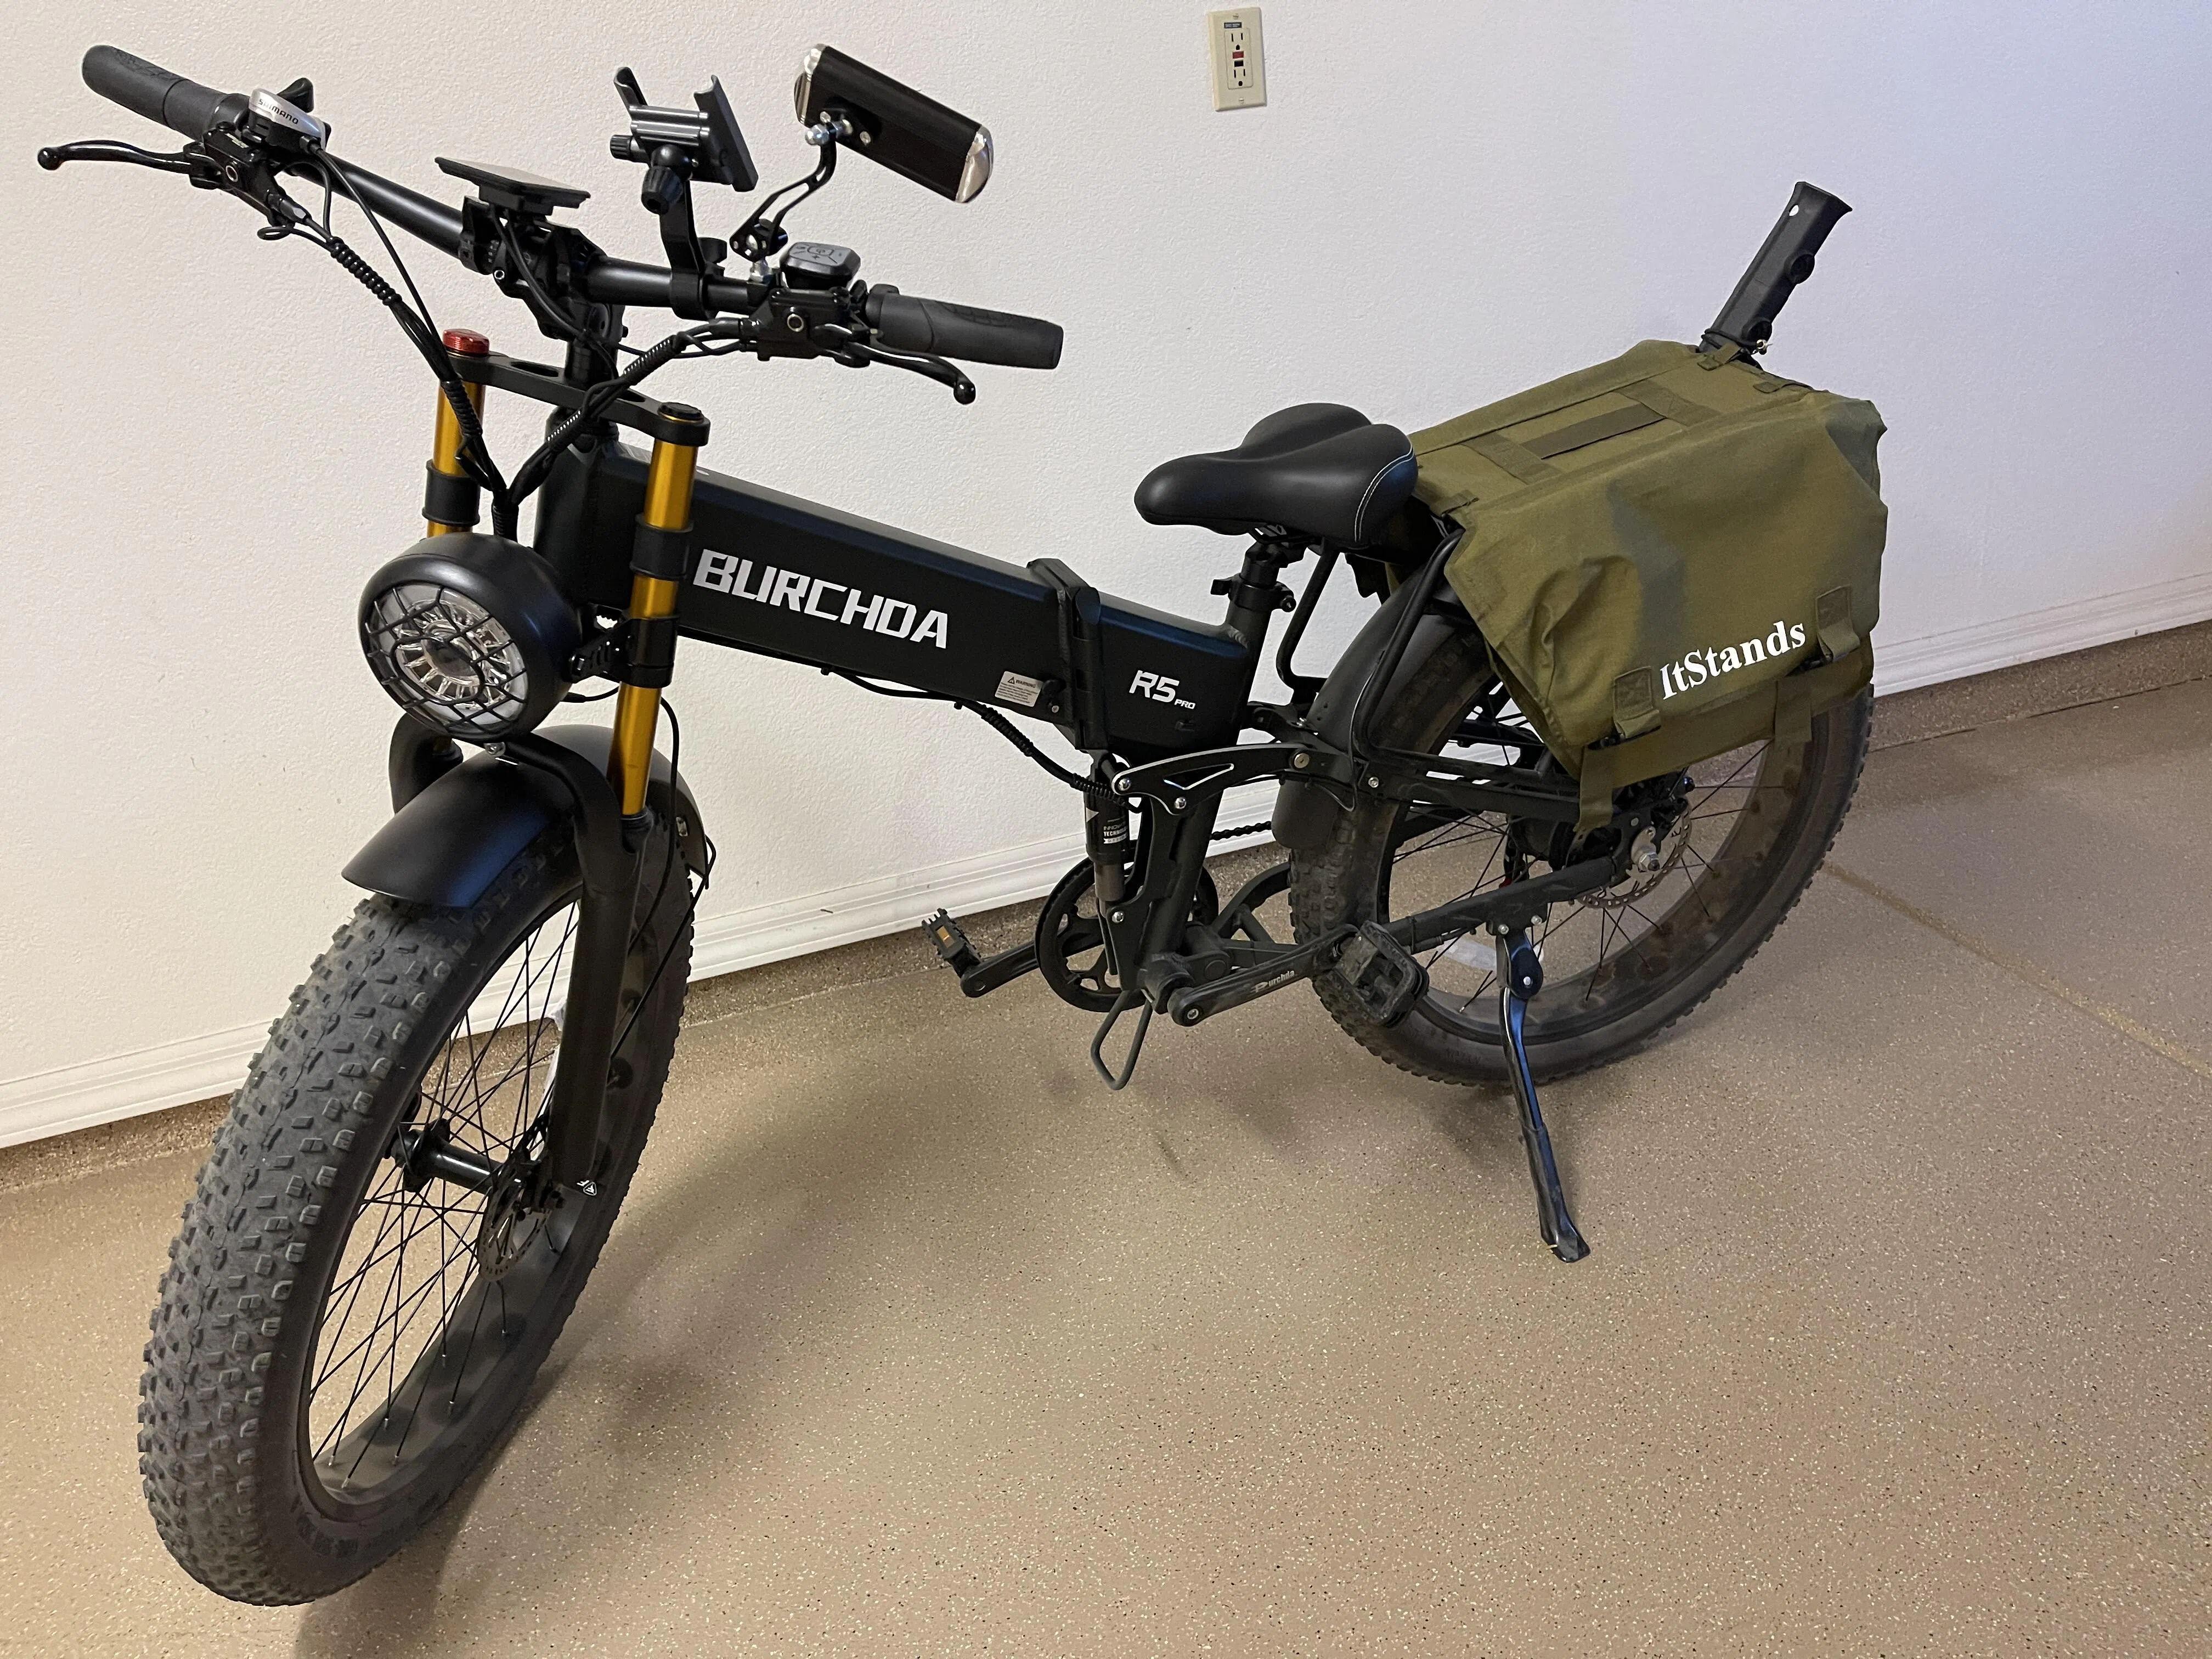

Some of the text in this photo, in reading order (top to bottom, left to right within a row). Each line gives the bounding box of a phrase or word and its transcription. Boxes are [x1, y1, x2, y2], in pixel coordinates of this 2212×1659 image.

[259, 98, 299, 124] SHIMANO
[1660, 620, 1806, 700] ItStands
[1015, 679, 1036, 689] WARNING
[1129, 670, 1196, 710] R5 PRO
